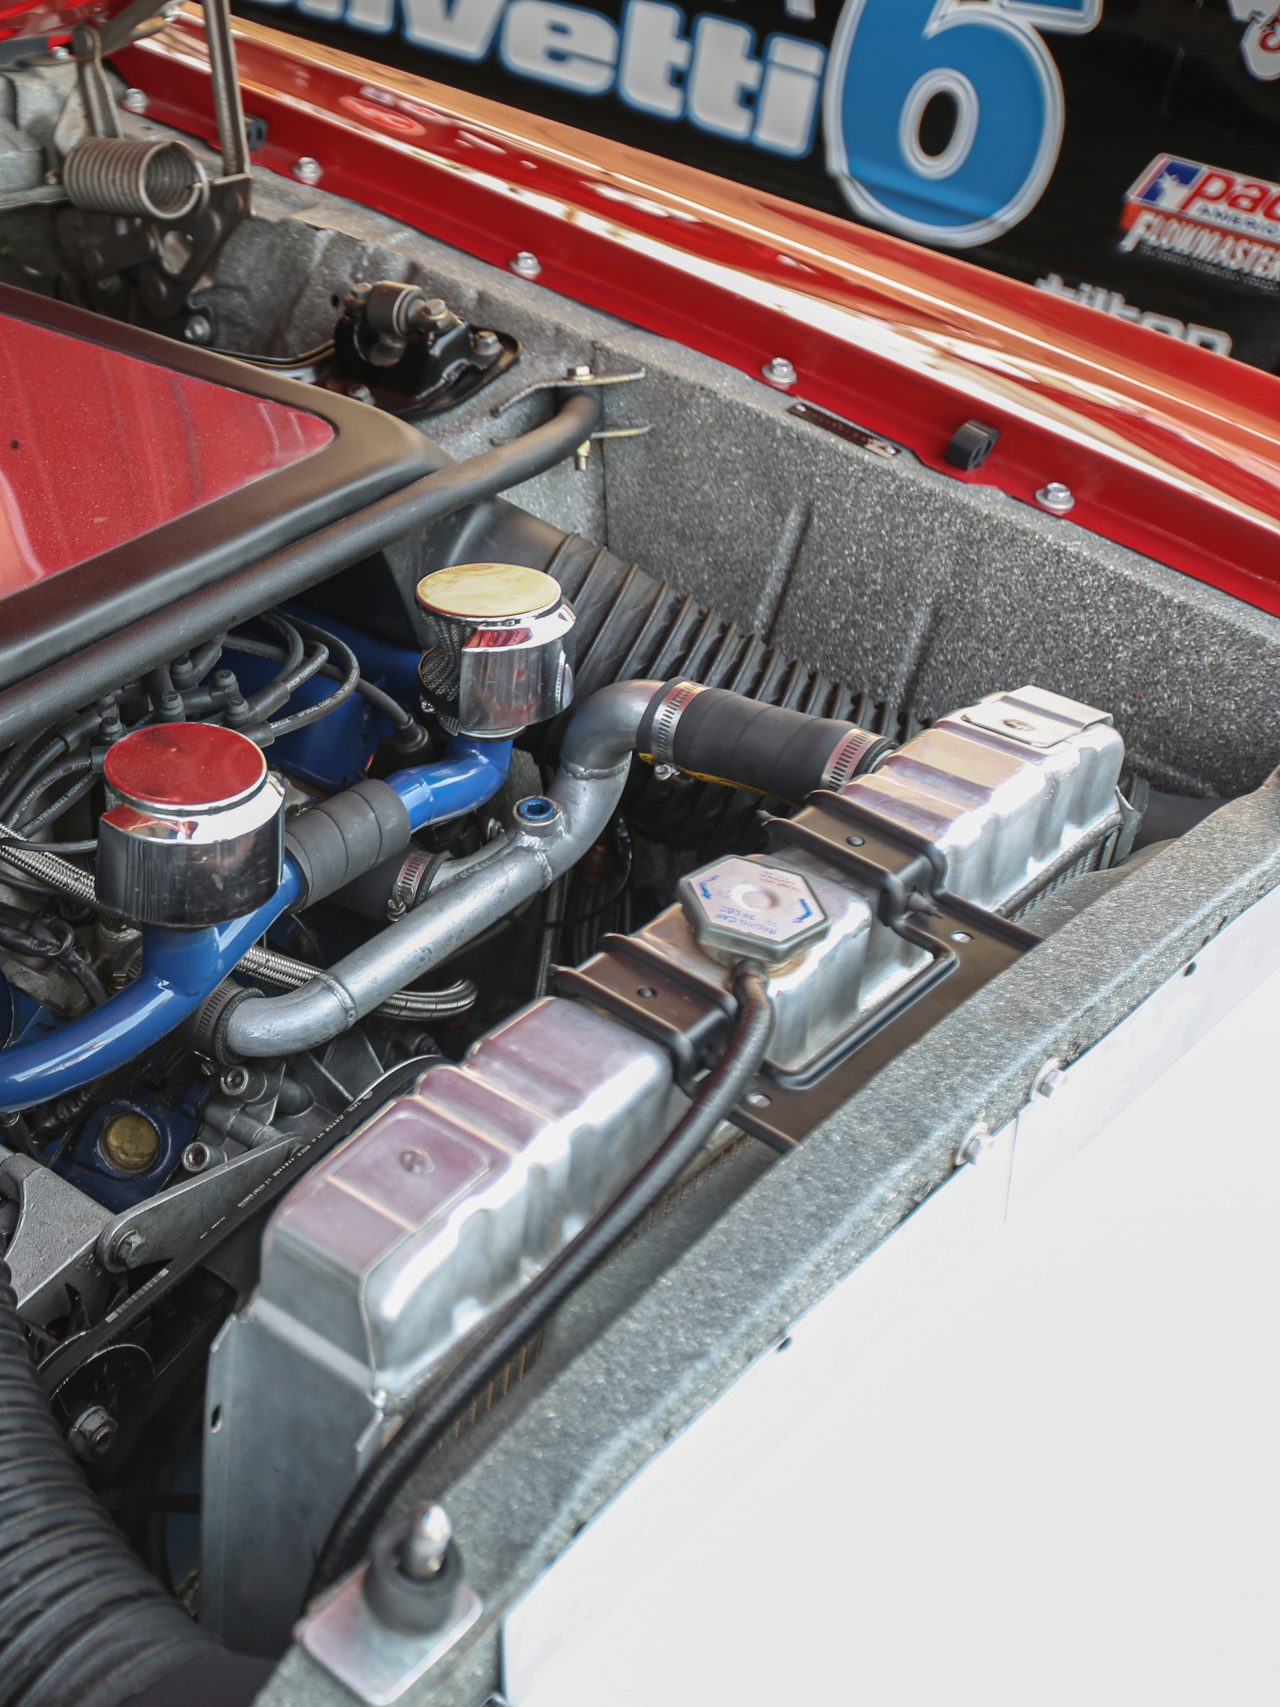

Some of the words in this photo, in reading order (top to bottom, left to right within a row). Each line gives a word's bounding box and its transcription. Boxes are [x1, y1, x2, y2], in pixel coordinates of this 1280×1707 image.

[260, 0, 826, 159] vetti
[822, 0, 1103, 248] 6
[1119, 209, 1280, 283] FLOWMASTE
